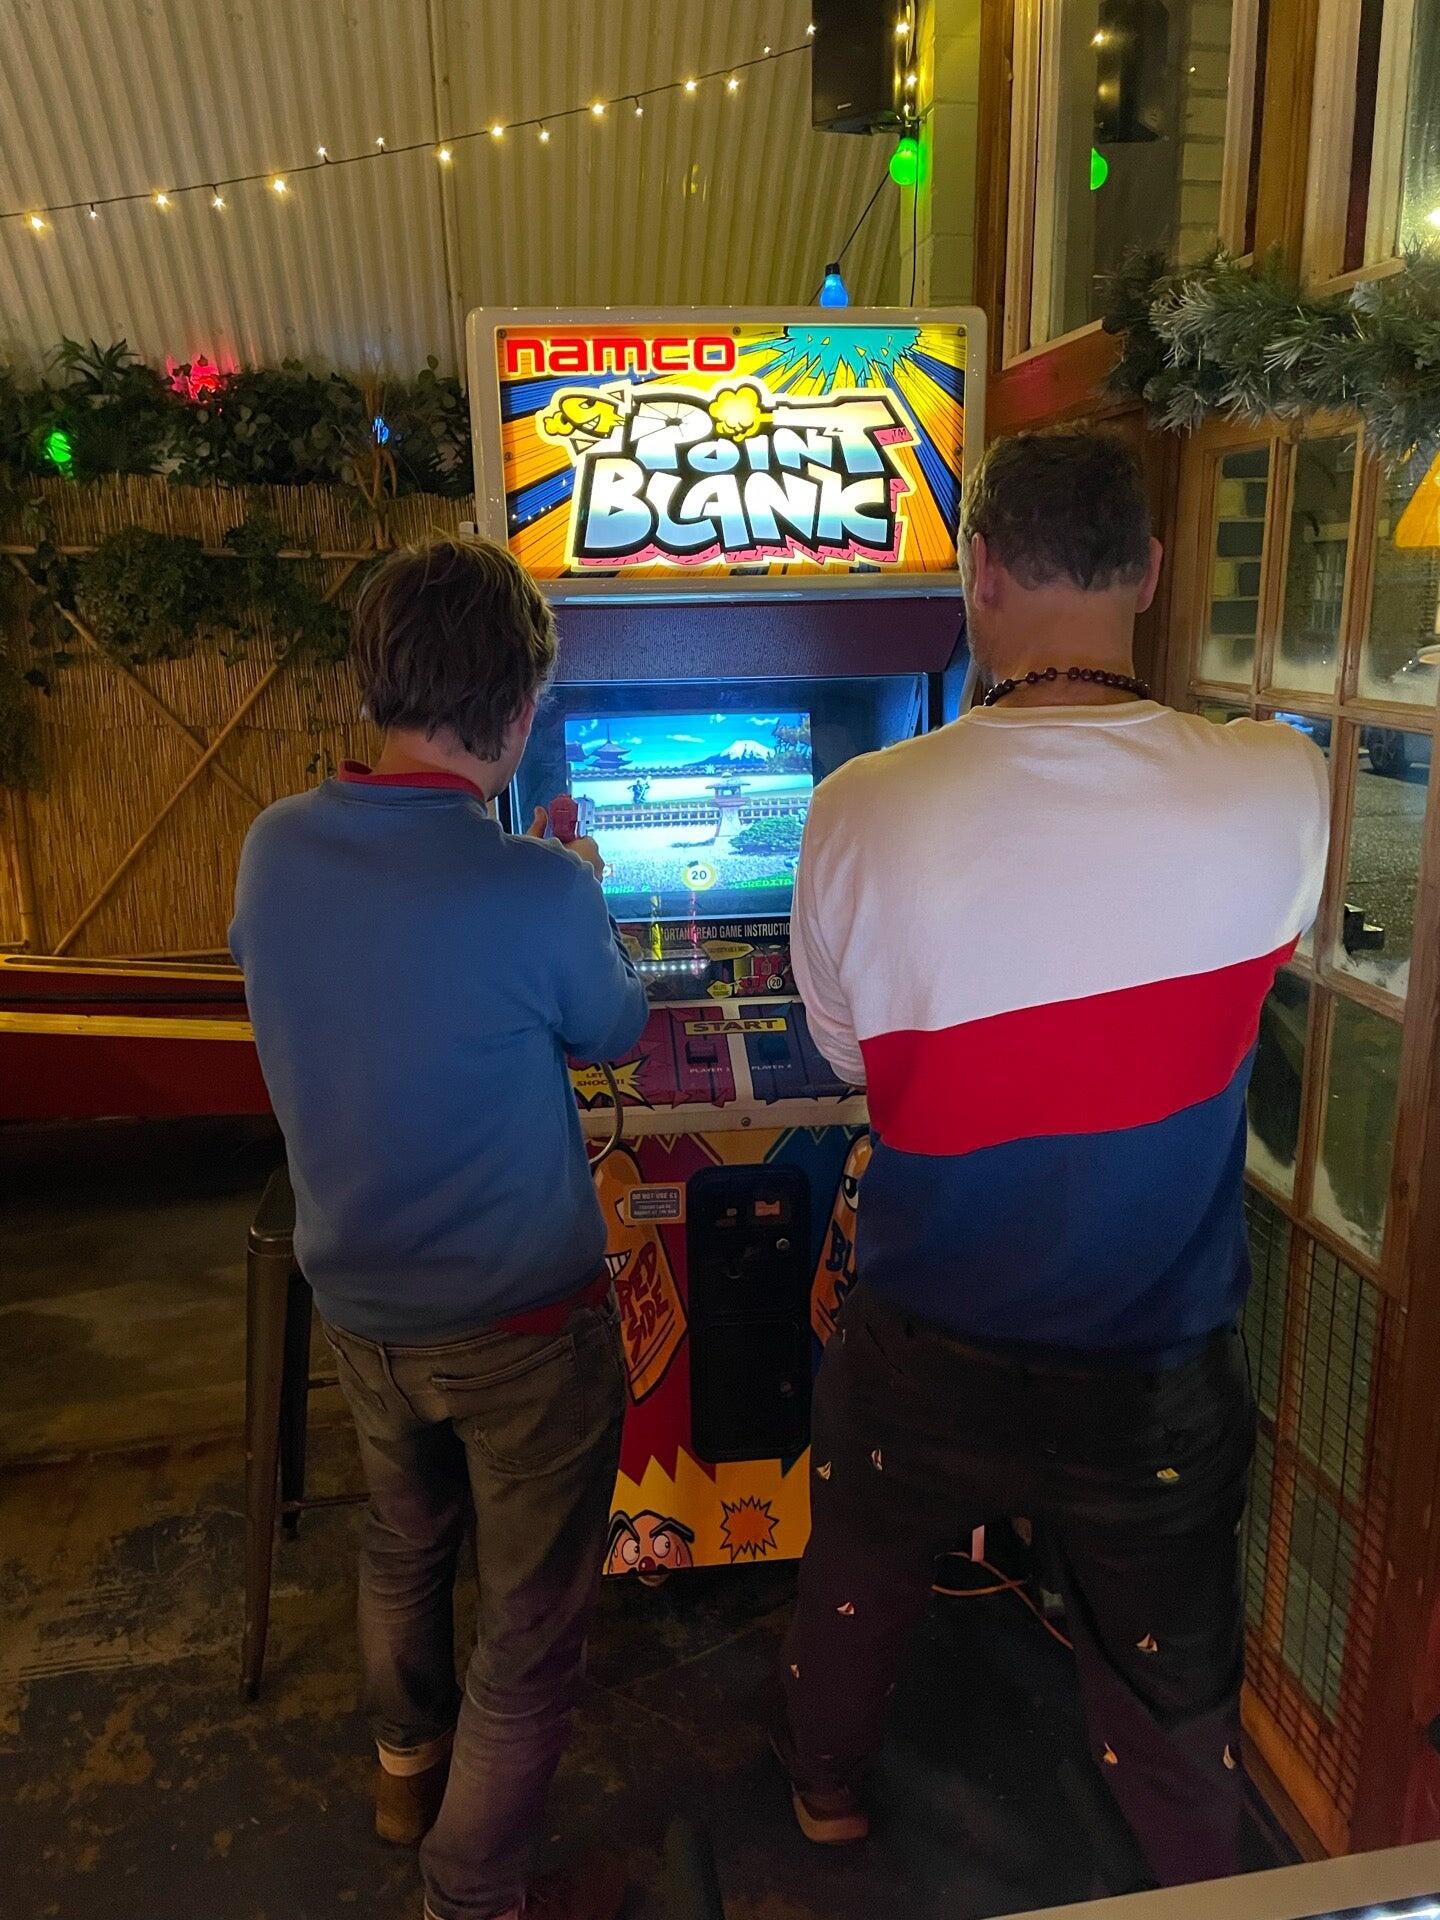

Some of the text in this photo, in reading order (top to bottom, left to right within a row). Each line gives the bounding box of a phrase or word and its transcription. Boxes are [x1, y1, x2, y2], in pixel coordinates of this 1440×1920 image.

[507, 336, 735, 373] namco
[892, 428, 907, 437] TM
[584, 457, 887, 549] BLANK
[691, 870, 707, 879] 20
[719, 925, 743, 938] GAME
[771, 978, 781, 987] 20
[693, 1020, 778, 1032] START
[615, 1241, 657, 1321] RED
